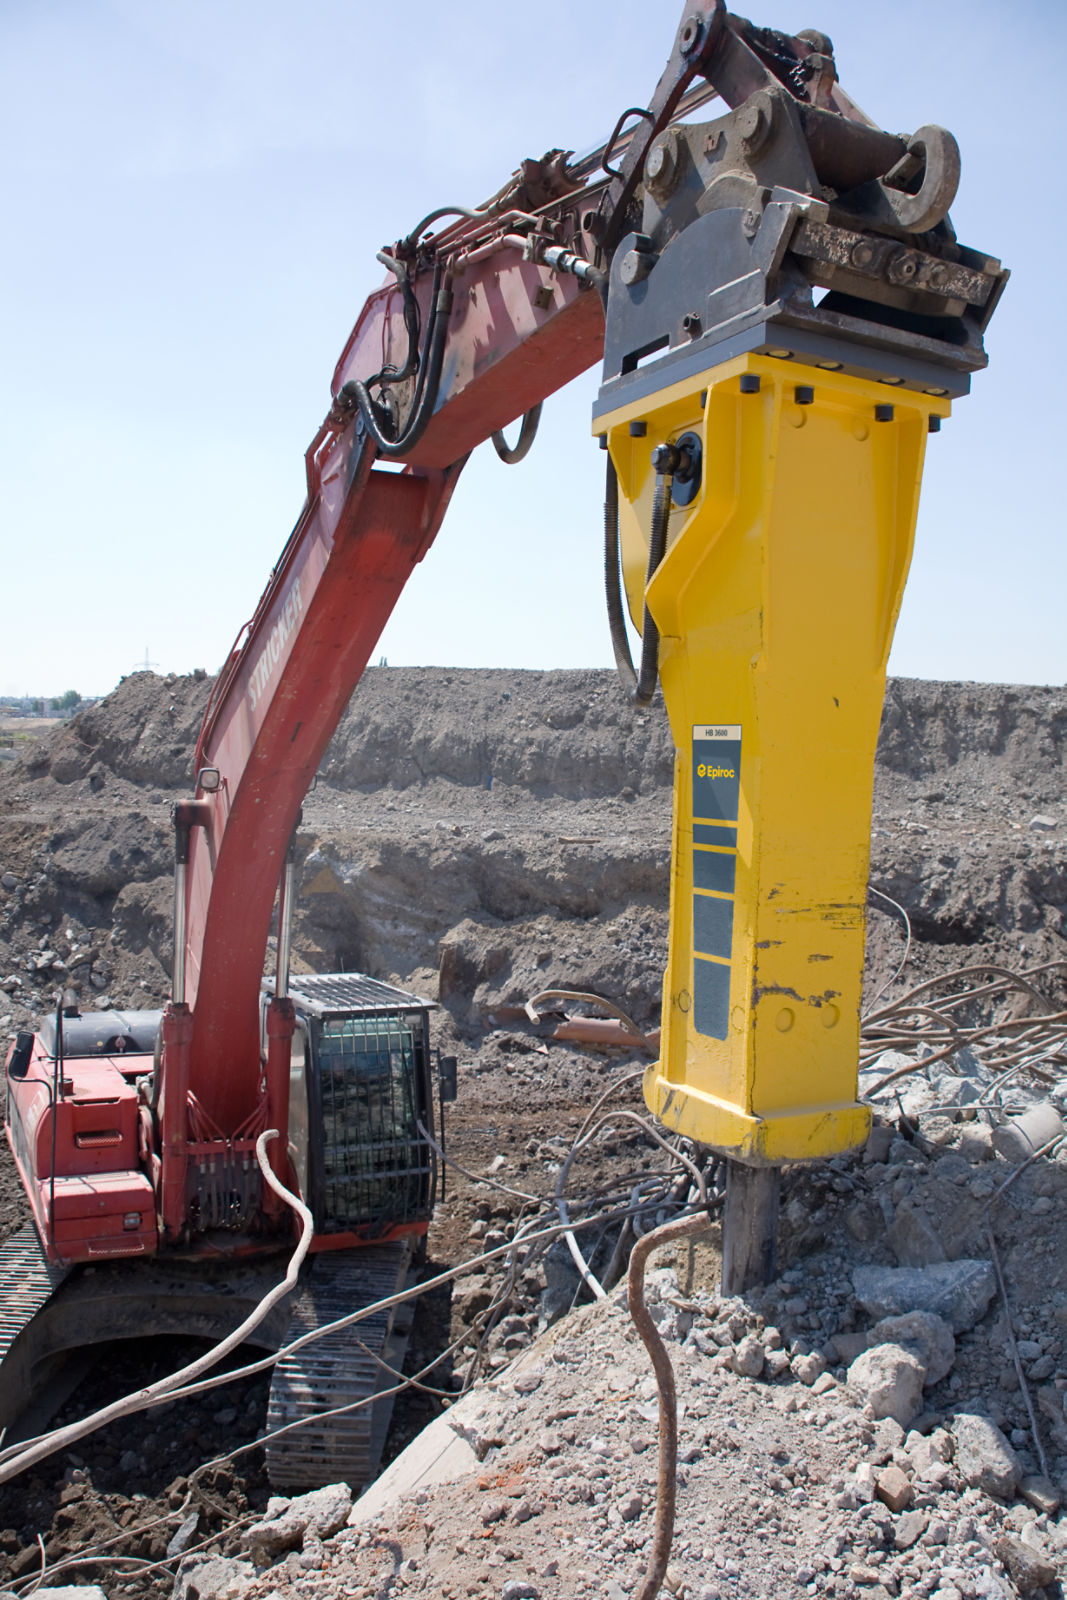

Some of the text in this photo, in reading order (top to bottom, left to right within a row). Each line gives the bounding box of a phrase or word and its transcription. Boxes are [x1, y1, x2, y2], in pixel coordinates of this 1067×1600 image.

[247, 577, 303, 712] STRICKER
[705, 729, 728, 737] HB 3600
[706, 765, 735, 780] Epiroc
